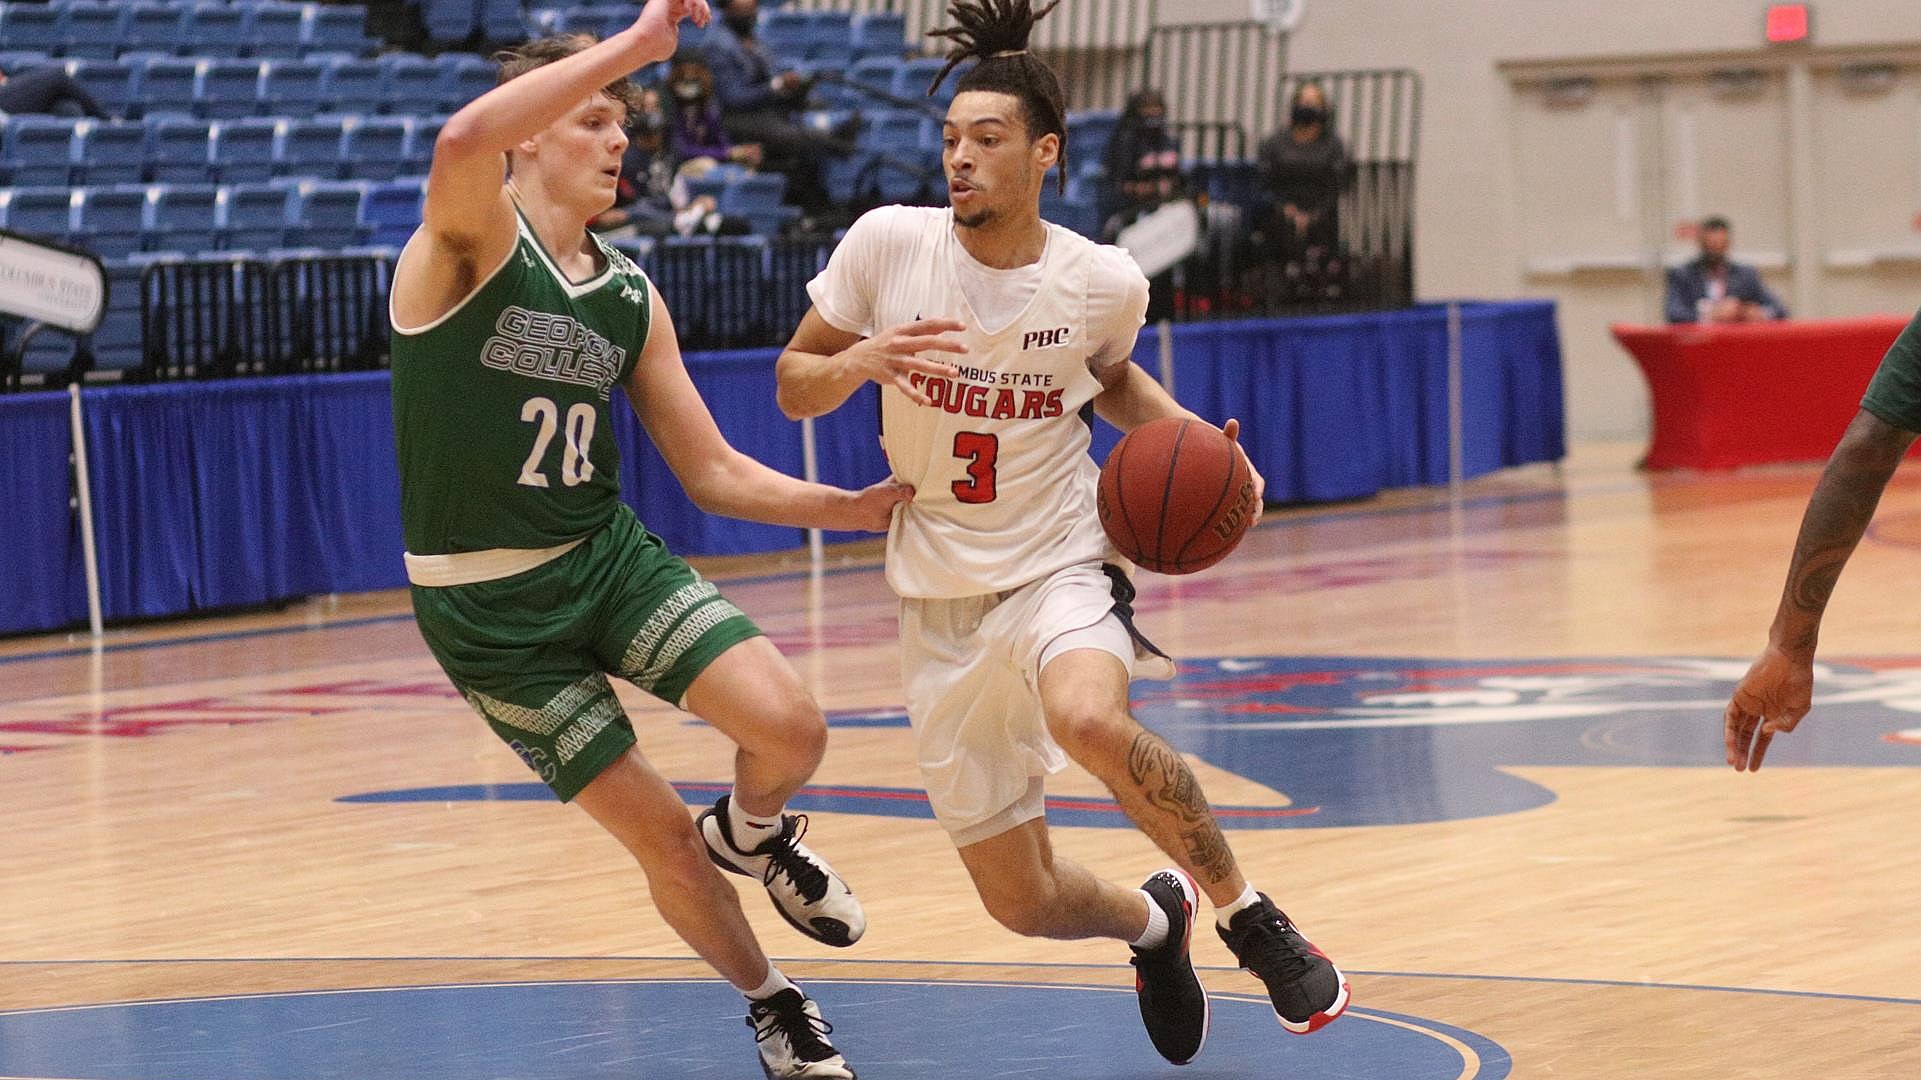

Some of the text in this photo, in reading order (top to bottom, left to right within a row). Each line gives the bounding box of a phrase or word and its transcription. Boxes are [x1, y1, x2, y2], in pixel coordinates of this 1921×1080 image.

[1022, 327, 1070, 350] PBC
[1001, 372, 1054, 387] STATE
[516, 396, 597, 488] 20
[951, 430, 999, 504] 3
